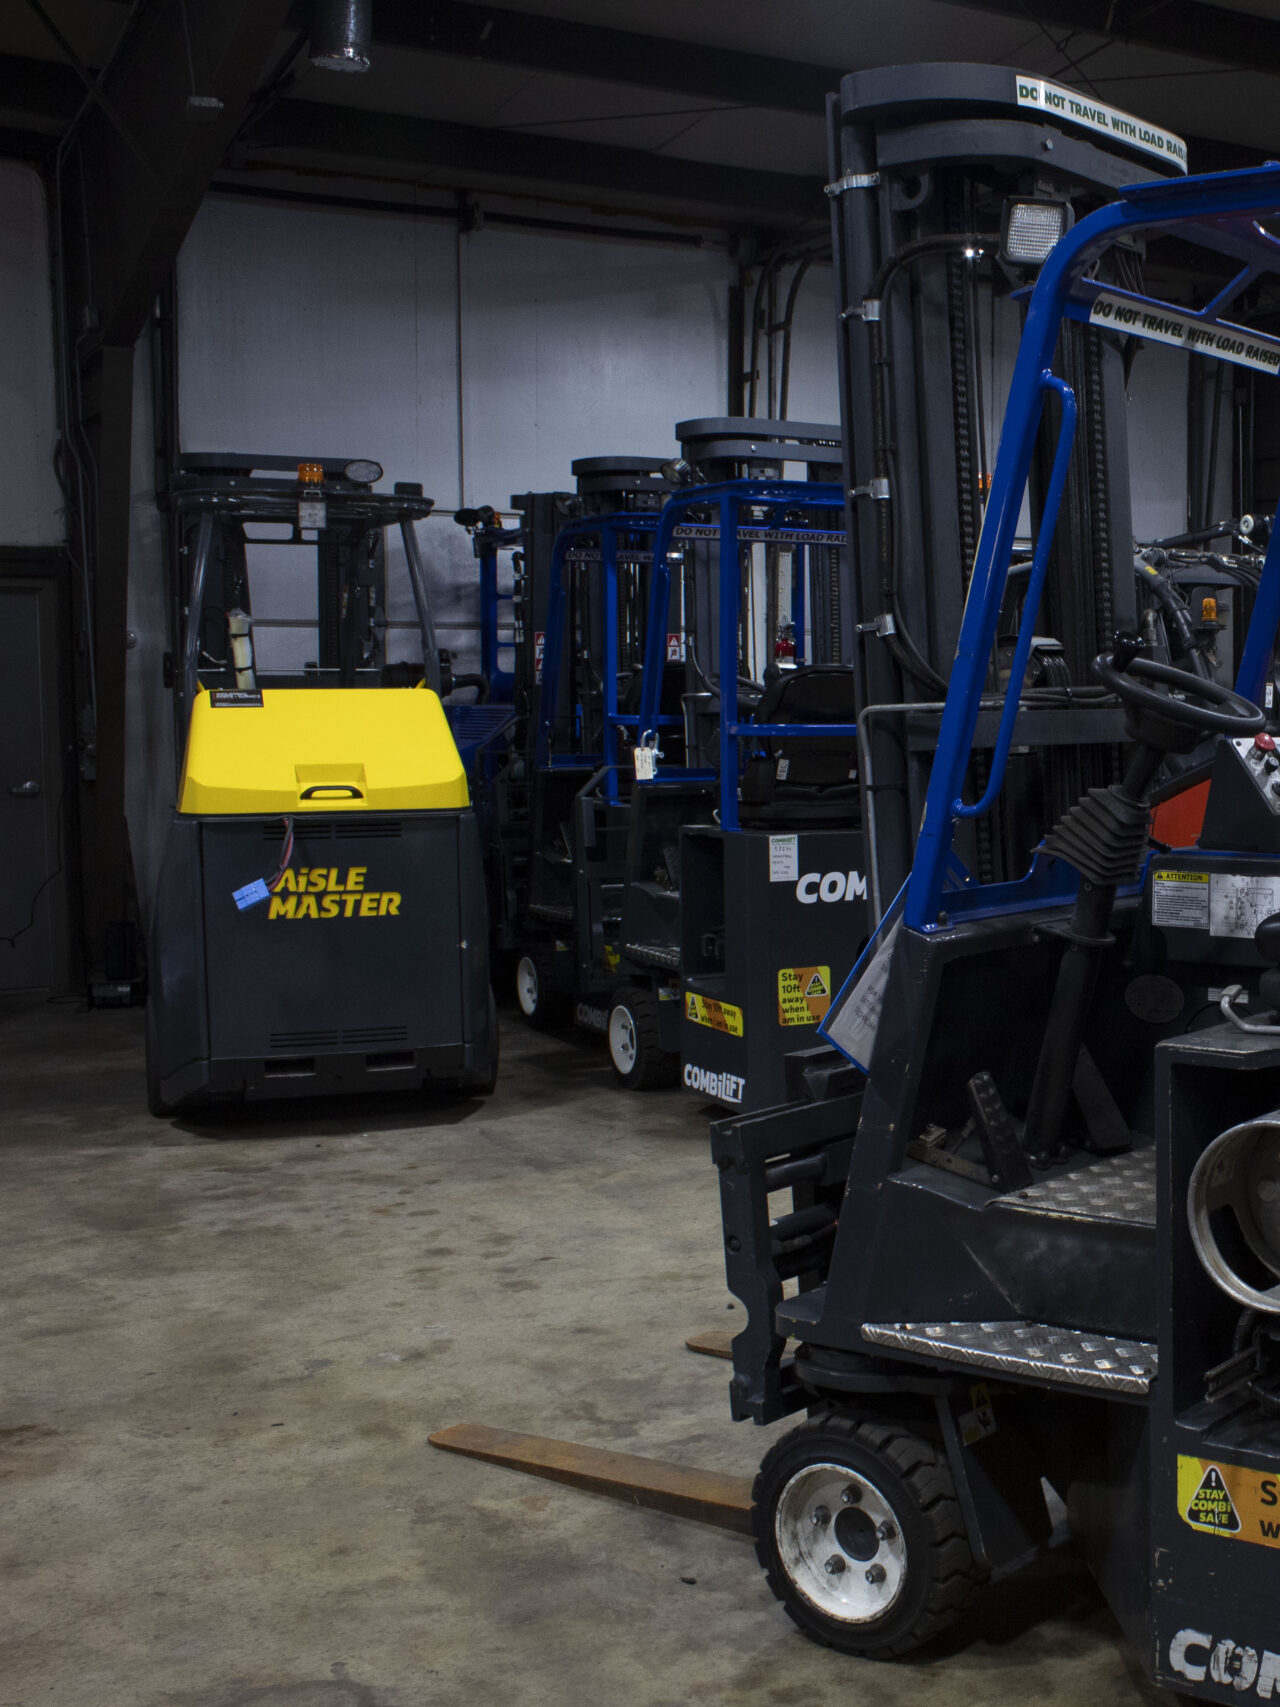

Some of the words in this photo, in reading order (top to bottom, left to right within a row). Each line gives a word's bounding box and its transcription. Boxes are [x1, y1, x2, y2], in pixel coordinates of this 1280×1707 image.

[1045, 91, 1066, 110] NOT
[1069, 100, 1108, 127] TRAVEL
[1111, 116, 1136, 138] WITH
[1139, 127, 1164, 149] LOAD
[1094, 301, 1113, 318] DO
[1115, 306, 1141, 326] NOT
[1142, 313, 1183, 338] TRAVEL
[1187, 326, 1213, 347] WITH
[1216, 334, 1243, 356] LOAD
[1245, 345, 1280, 367] RAISED
[676, 528, 692, 537] DO
[695, 528, 717, 538] NOT
[738, 530, 761, 539] AVEL
[764, 531, 793, 541] WITH
[796, 533, 823, 542] LOAD
[267, 891, 402, 920] MASTER
[782, 972, 804, 983] Stay
[782, 983, 801, 994] 10ft
[782, 996, 805, 1005] away
[782, 1005, 805, 1013] when
[797, 1014, 805, 1022] in
[1198, 1488, 1226, 1501] STAY
